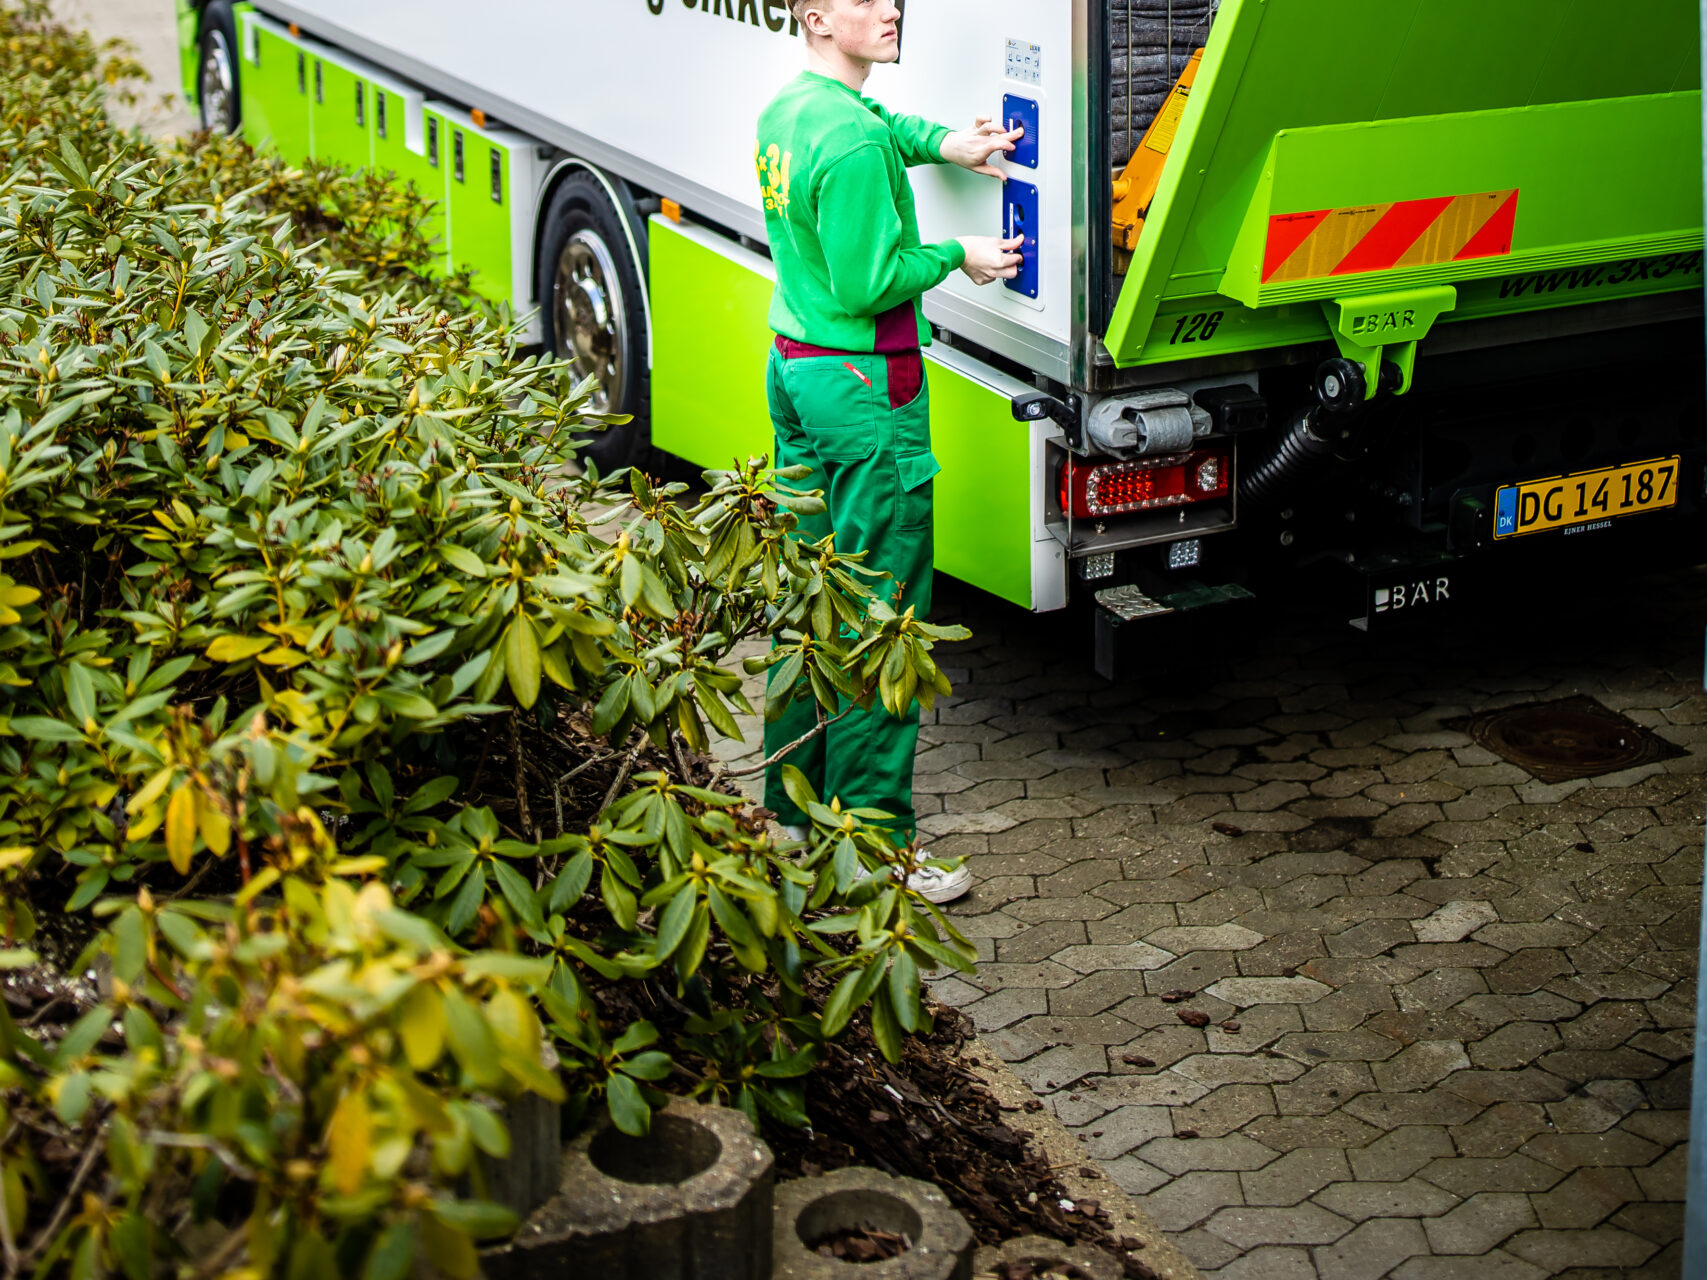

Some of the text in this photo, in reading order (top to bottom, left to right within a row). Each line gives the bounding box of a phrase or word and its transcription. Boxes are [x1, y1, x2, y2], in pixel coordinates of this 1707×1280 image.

[1170, 311, 1224, 345] 126
[1367, 310, 1416, 333] BÄR
[1520, 465, 1674, 527] DG 14 187
[1500, 516, 1512, 527] DK
[1564, 520, 1612, 535] EJNER HESSEL
[1393, 577, 1450, 610] BÄR
